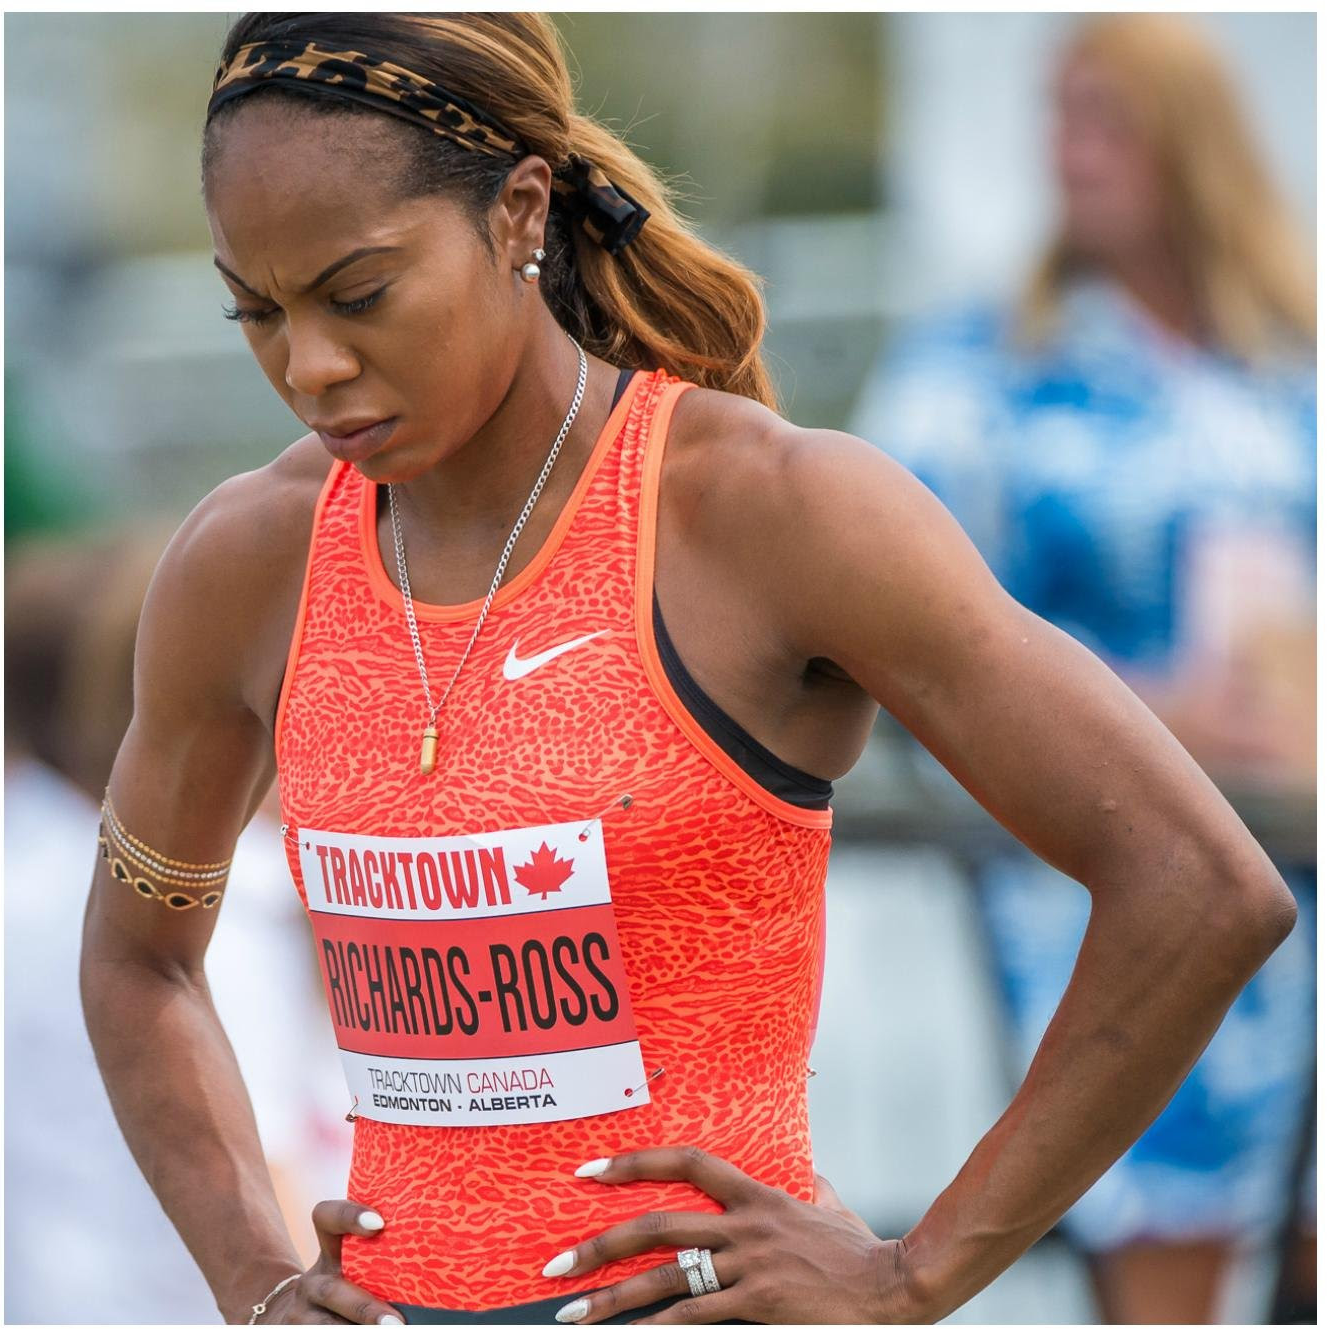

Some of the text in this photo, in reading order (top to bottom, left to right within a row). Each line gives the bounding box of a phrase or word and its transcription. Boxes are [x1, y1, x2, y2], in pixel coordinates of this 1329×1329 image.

[316, 844, 512, 911] TRACKTOWN
[322, 931, 620, 1037] RICHARDS-ROSS
[367, 1068, 555, 1095] TRACKTOWN CANADA
[372, 1094, 452, 1113] EDMONTON
[468, 1094, 557, 1113] ALBERTA
